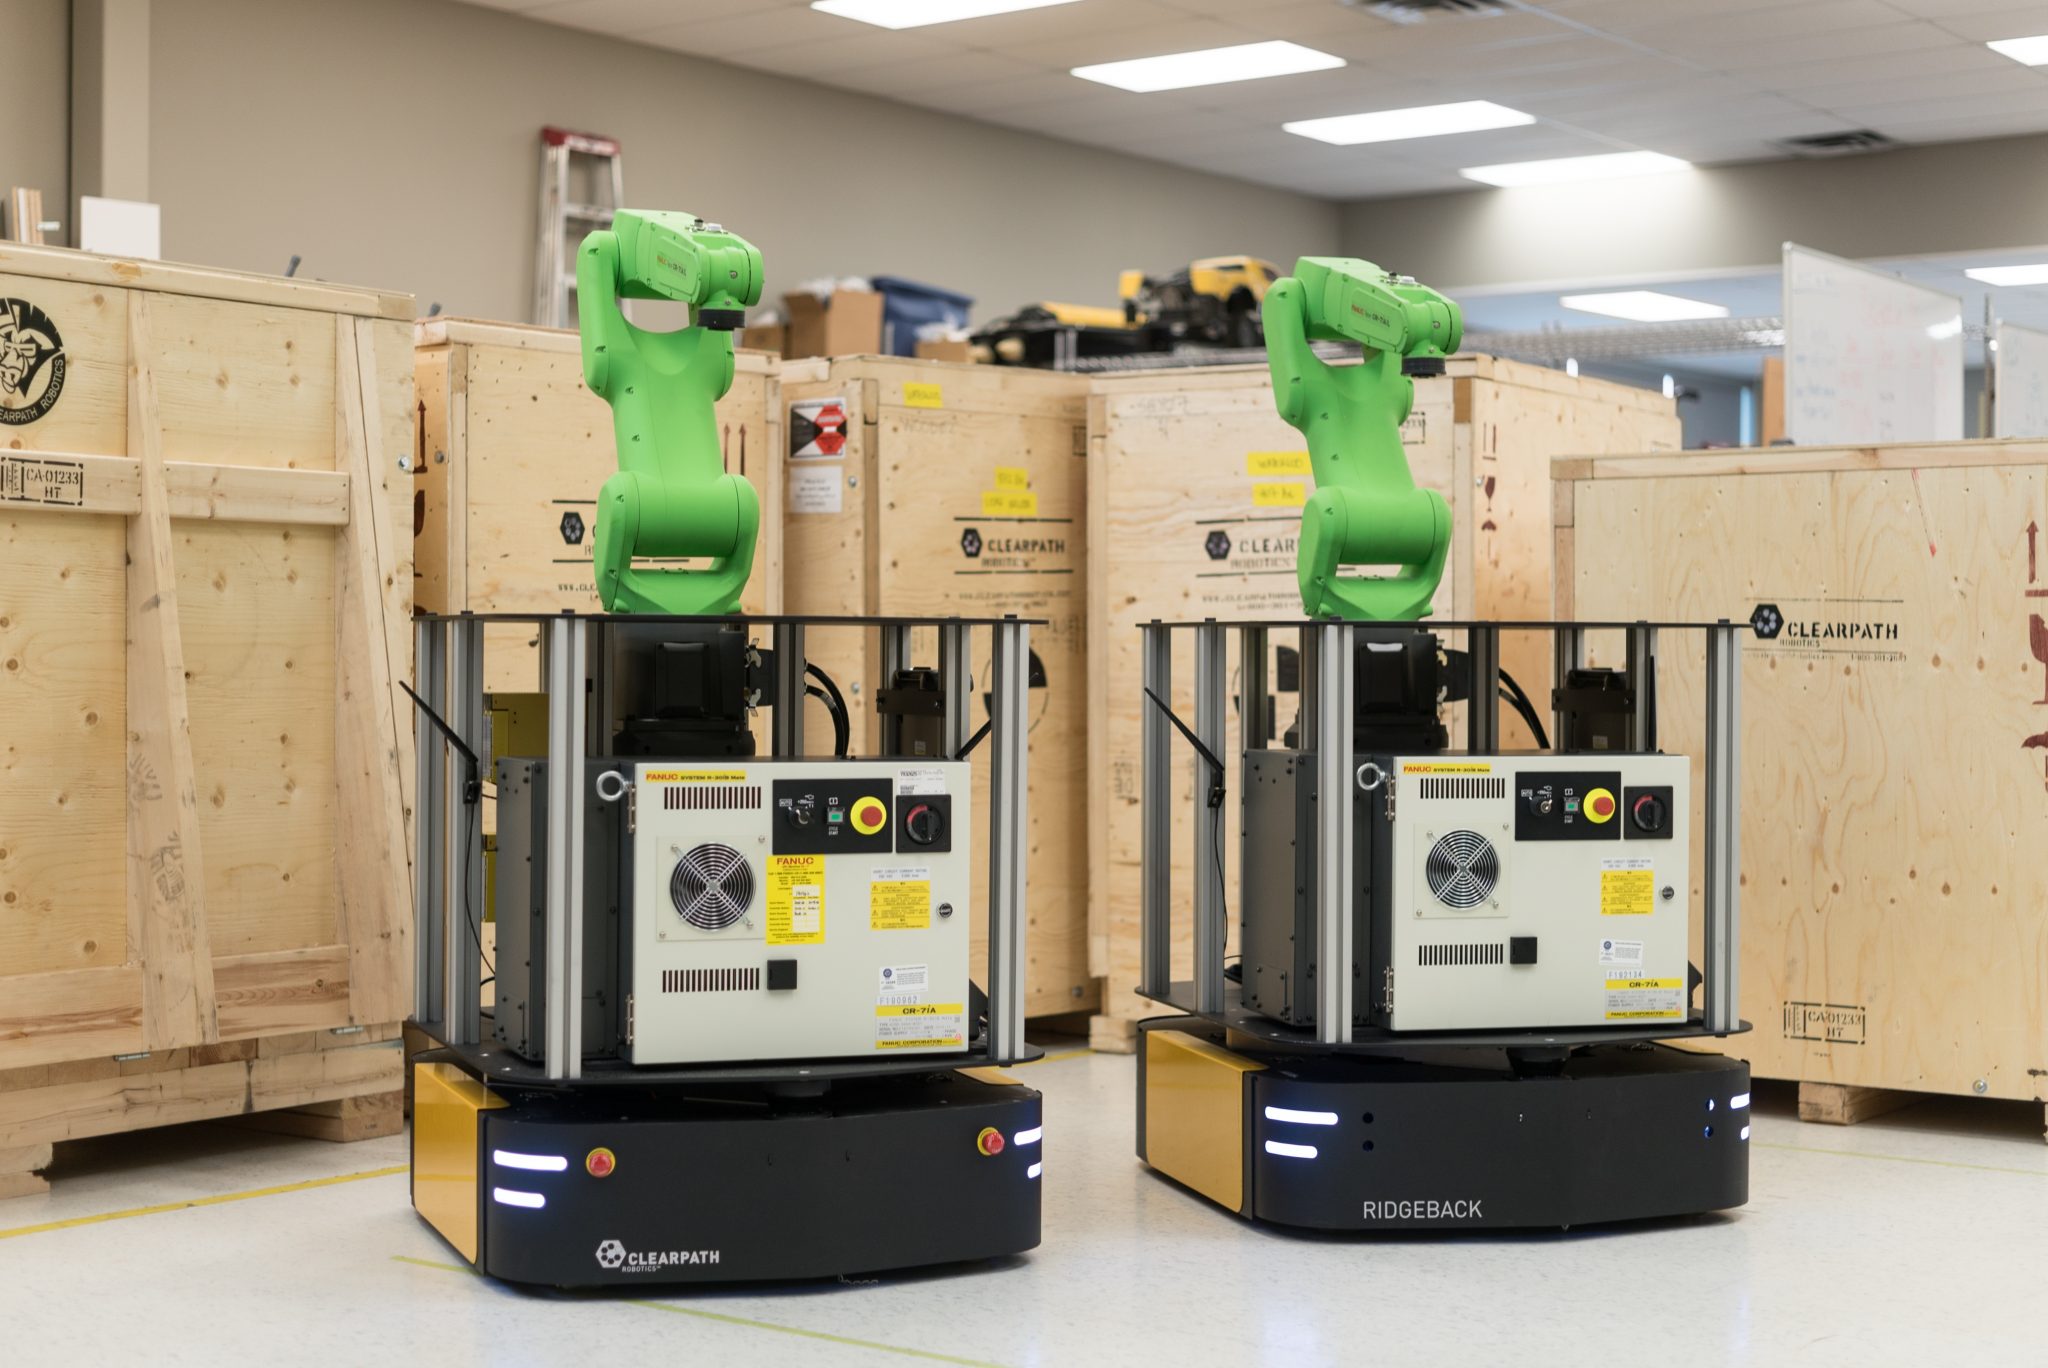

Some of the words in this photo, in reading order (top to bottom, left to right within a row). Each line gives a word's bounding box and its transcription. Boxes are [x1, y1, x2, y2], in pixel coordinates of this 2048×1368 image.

[40, 359, 64, 410] ROBOTICS
[45, 486, 61, 498] HT
[987, 539, 1065, 553] CLEARPATH
[1788, 622, 1898, 640] CLEARPATH
[777, 857, 814, 865] FANUC
[903, 1004, 936, 1015] CR-7iA
[1363, 1200, 1482, 1220] RIDGEBACK
[628, 1250, 720, 1265] CLEARPATH
